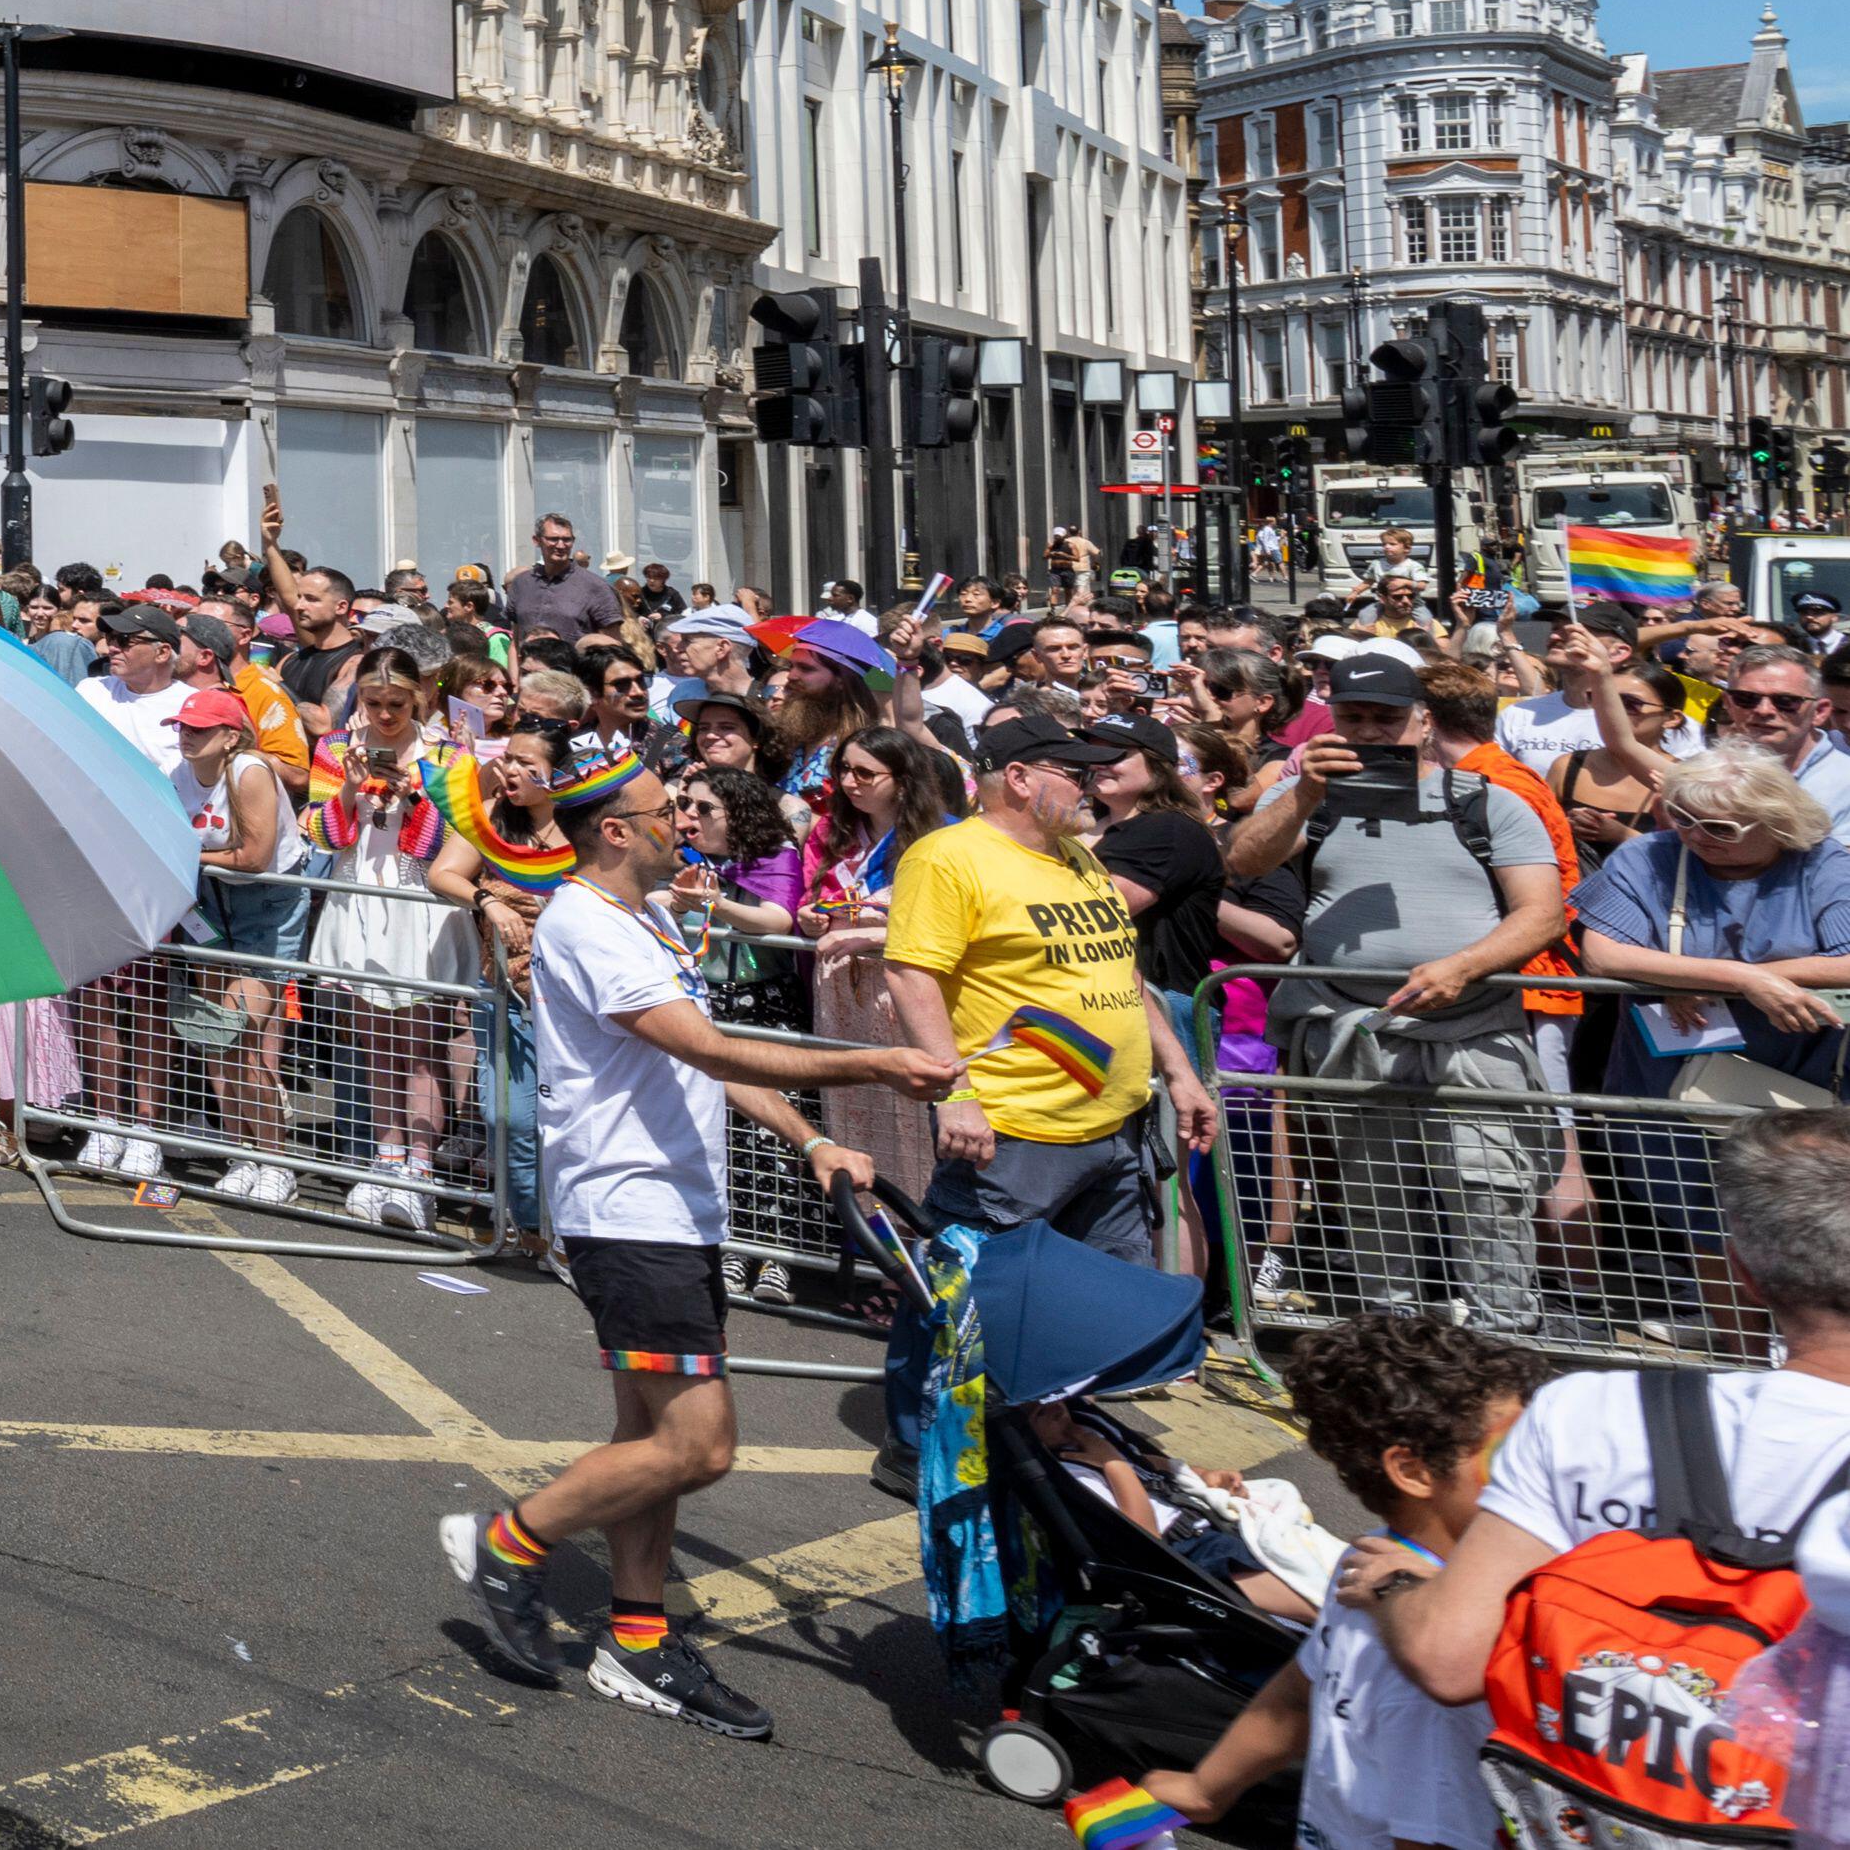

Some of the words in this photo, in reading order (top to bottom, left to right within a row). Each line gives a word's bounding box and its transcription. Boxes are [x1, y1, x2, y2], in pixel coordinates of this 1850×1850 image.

[1517, 737, 1556, 752] Pride
[1561, 740, 1573, 753] is
[1044, 944, 1071, 965] IN
[1562, 1670, 1737, 1801] EPIC
